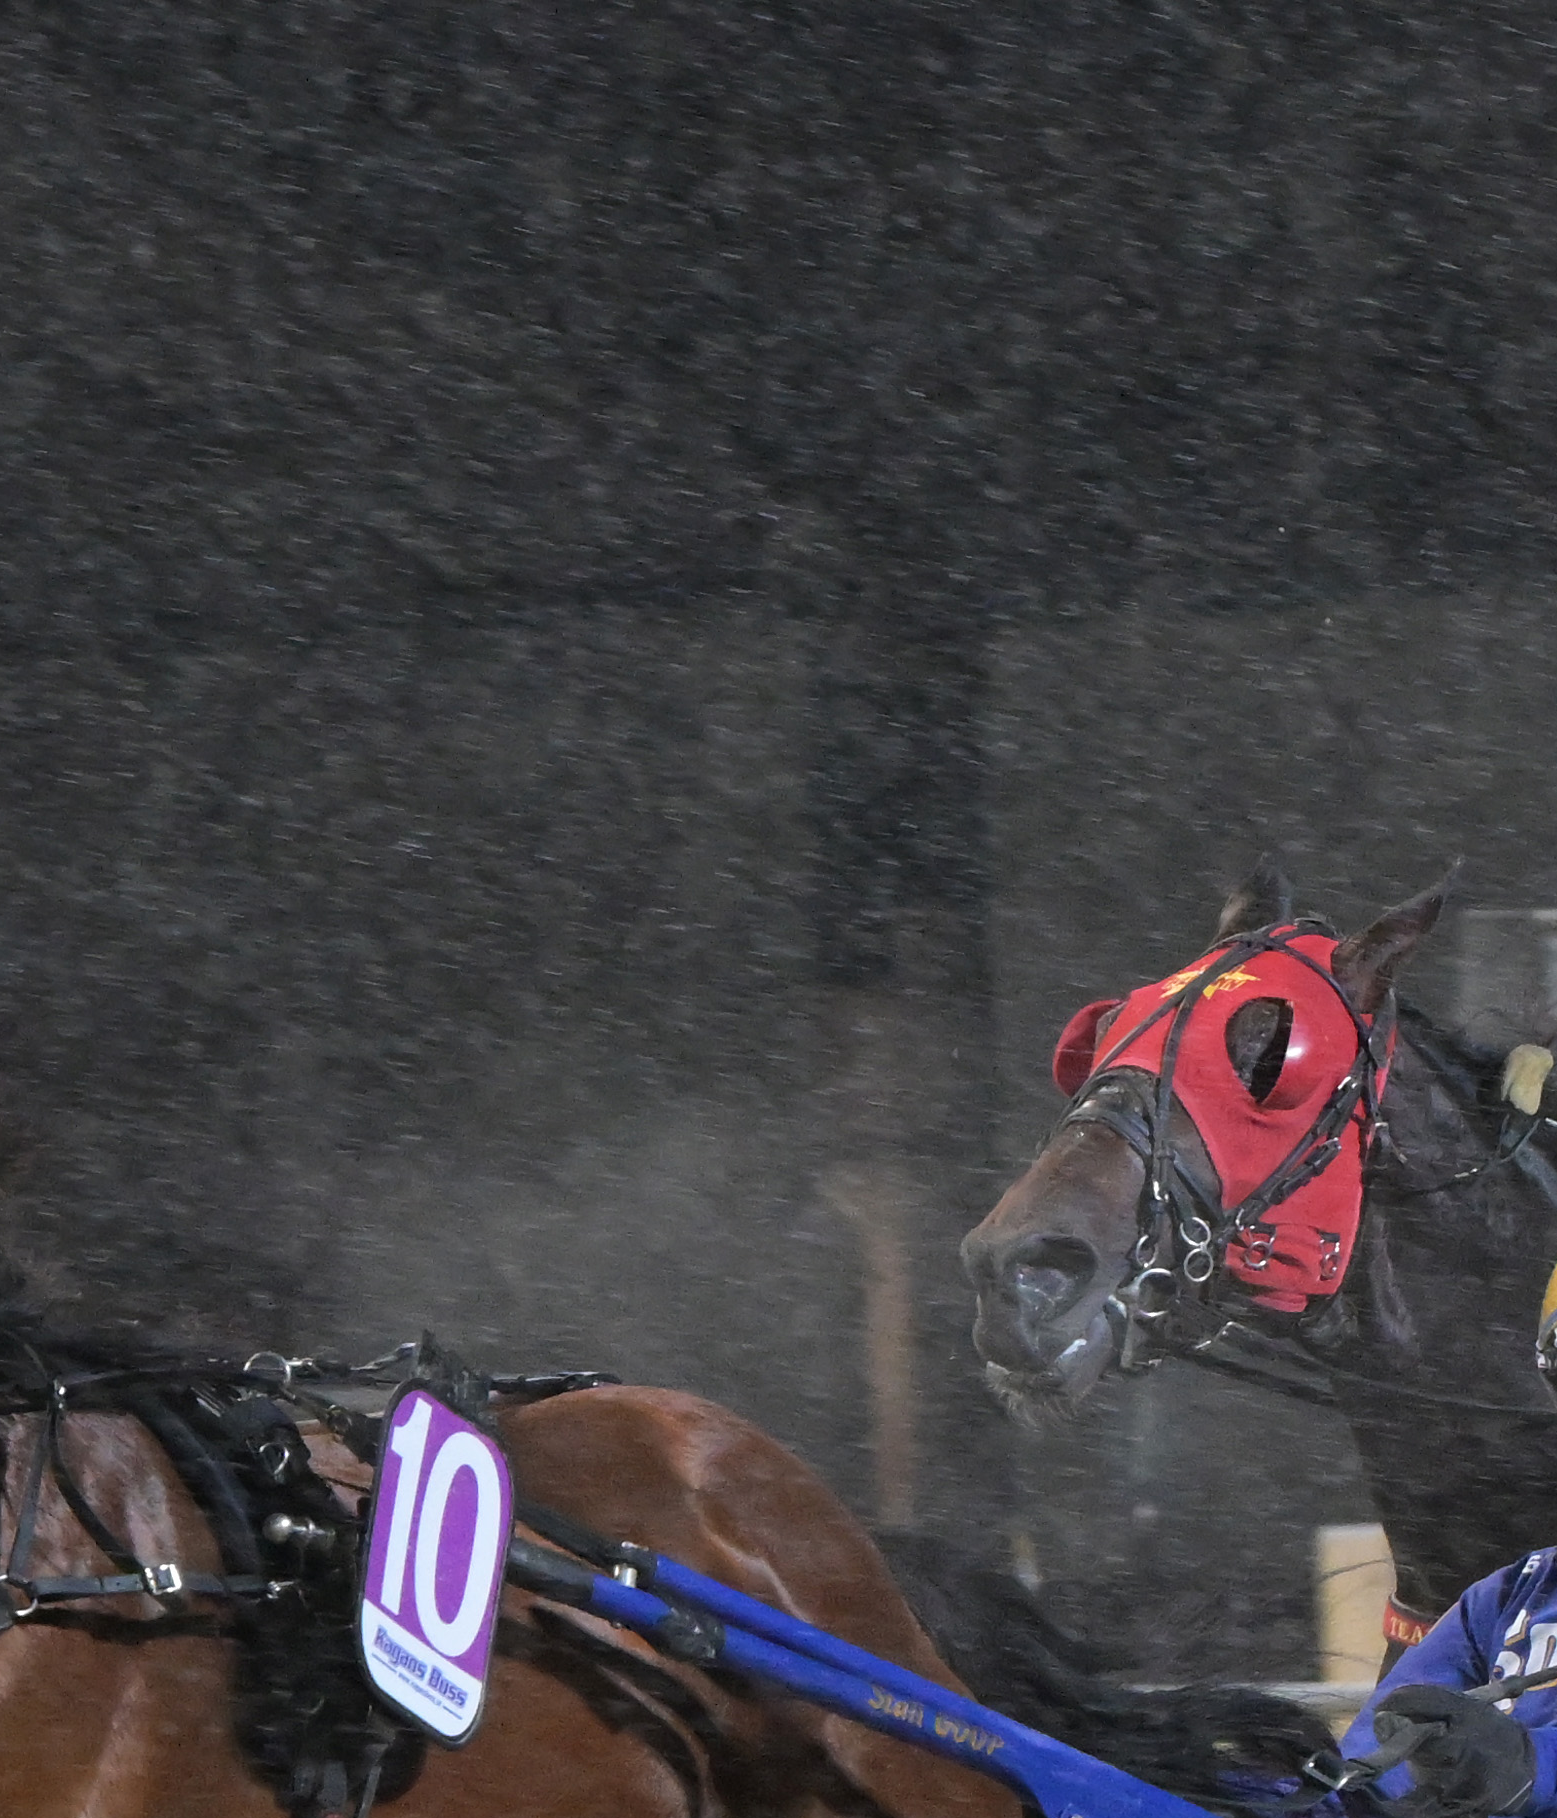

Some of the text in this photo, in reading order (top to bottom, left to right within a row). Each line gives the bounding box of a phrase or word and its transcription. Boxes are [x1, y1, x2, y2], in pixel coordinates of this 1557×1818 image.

[381, 1397, 501, 1658] 10
[373, 1624, 428, 1682] Kagans
[427, 1665, 468, 1709] Buss
